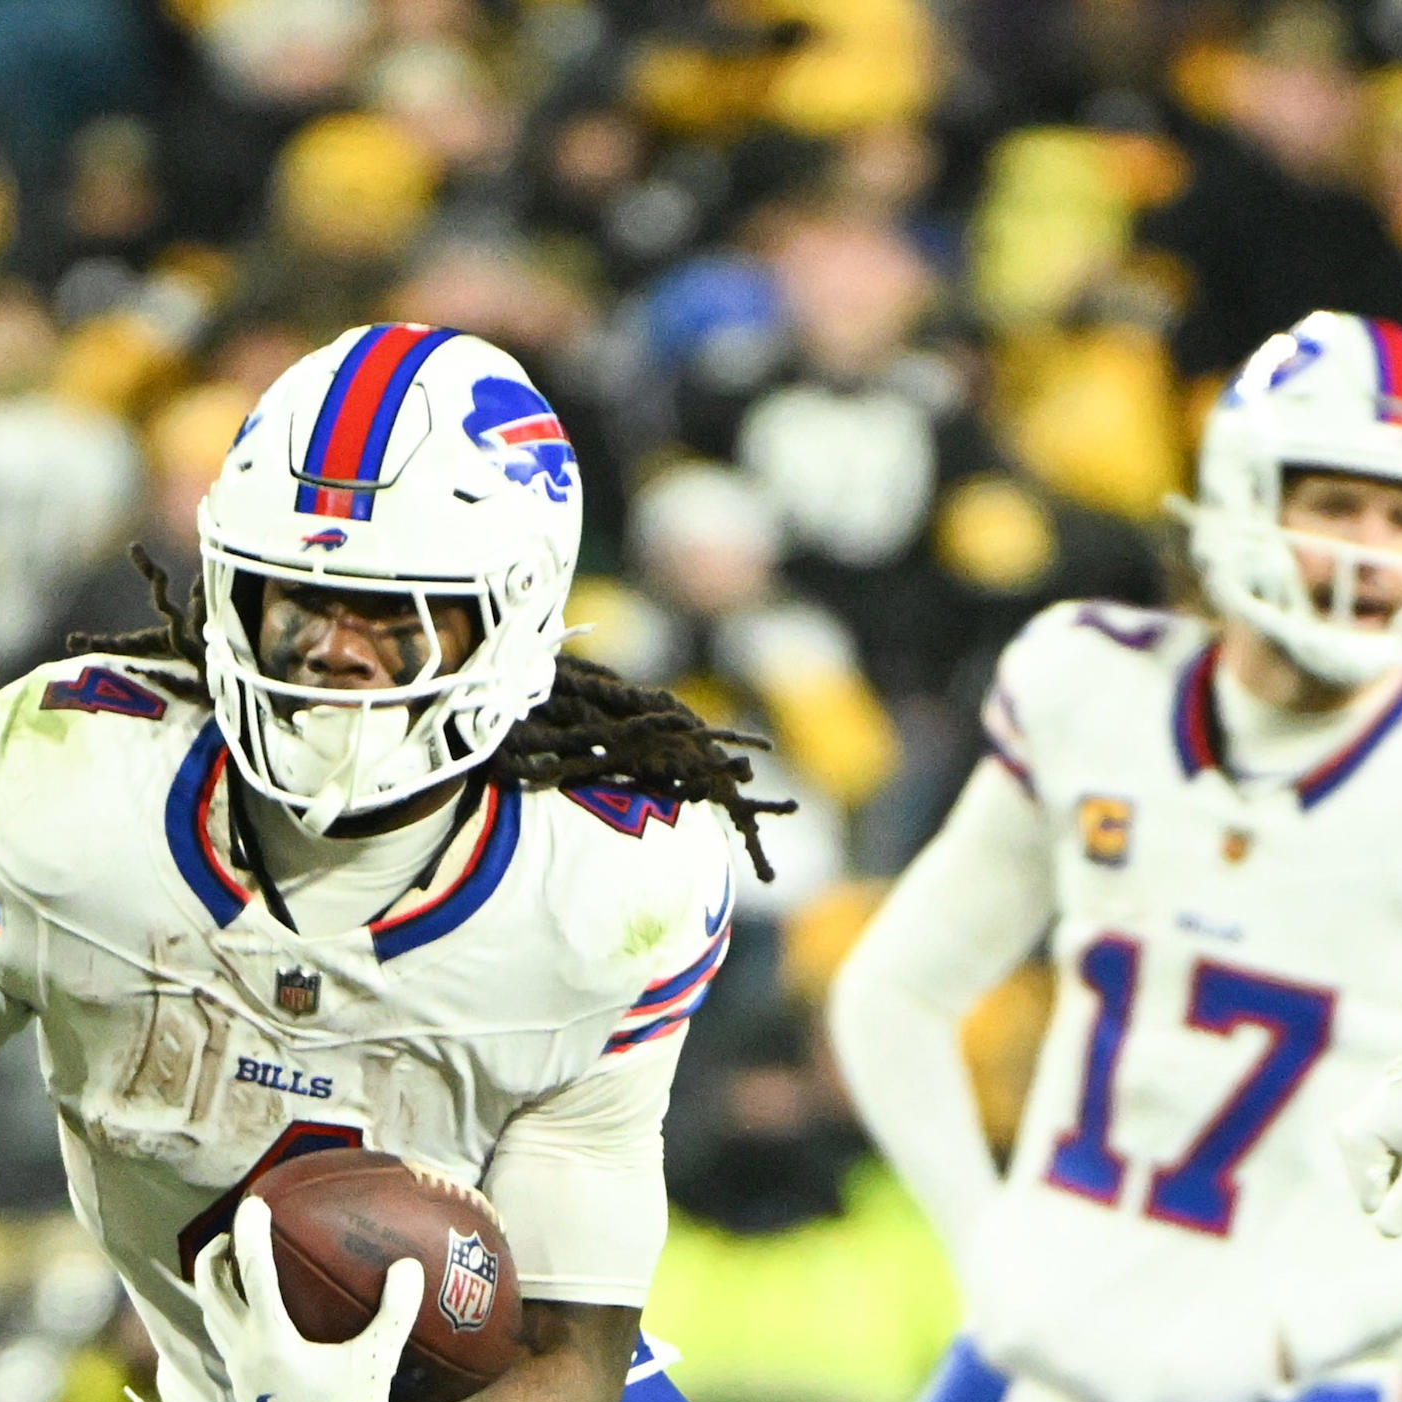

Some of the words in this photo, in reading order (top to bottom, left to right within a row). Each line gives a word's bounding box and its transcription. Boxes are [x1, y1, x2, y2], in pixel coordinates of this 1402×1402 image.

[38, 666, 169, 721] 4
[558, 780, 682, 840] 4
[235, 1056, 333, 1099] BILLS
[1041, 929, 1338, 1239] 17
[446, 1268, 488, 1321] NFL
